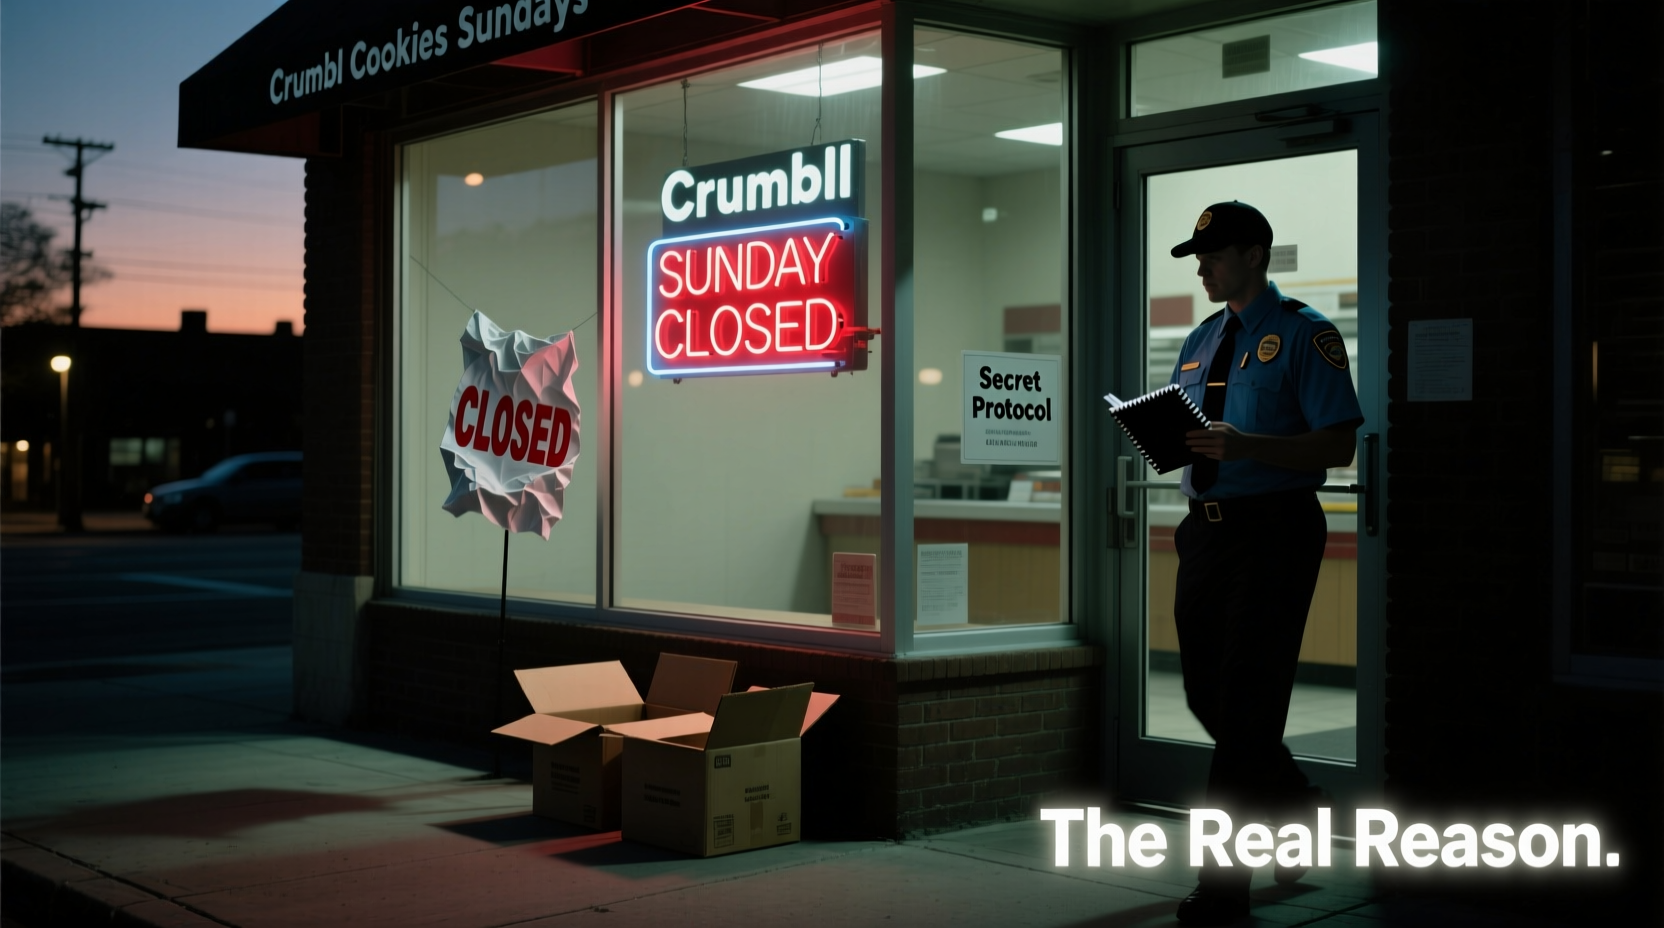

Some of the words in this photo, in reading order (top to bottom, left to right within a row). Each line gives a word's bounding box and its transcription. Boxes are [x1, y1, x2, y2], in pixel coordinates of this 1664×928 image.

[269, 48, 344, 105] Crumbl
[350, 21, 448, 80] Cookies
[661, 143, 852, 222] Crumbll
[658, 231, 836, 298] SUNDAY
[654, 297, 838, 360] CLOSED
[972, 395, 1052, 422] Protocol
[979, 365, 1042, 392] Secret
[454, 385, 572, 468] CLOSED
